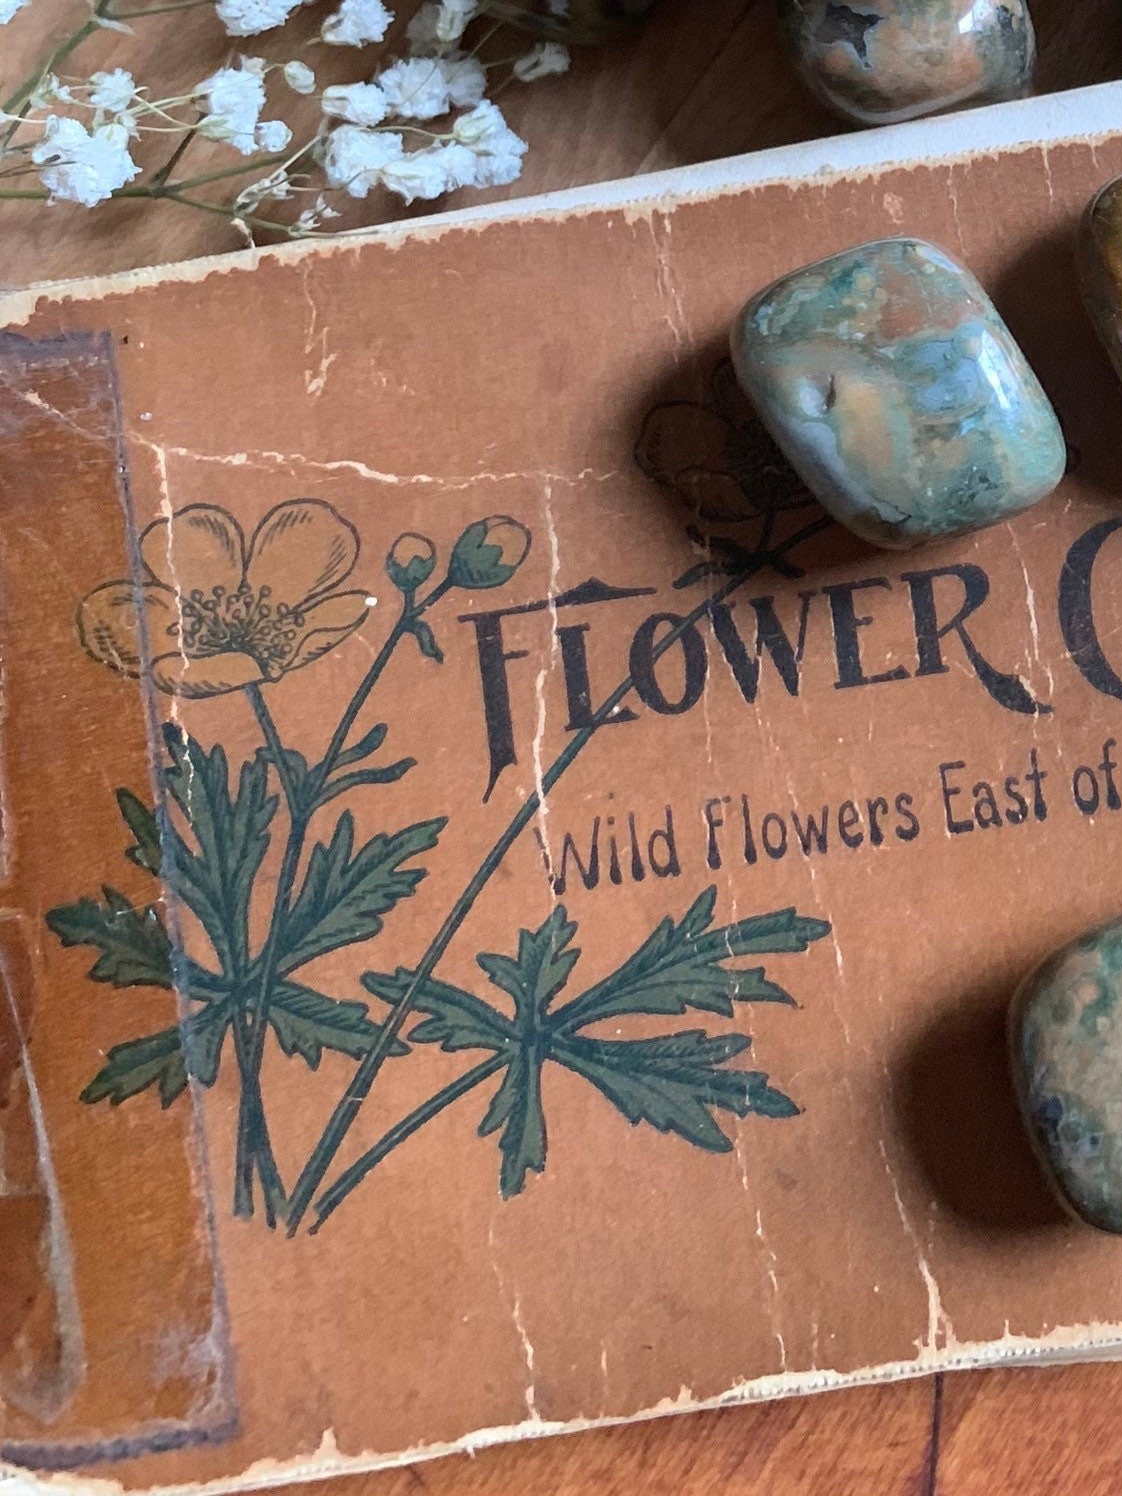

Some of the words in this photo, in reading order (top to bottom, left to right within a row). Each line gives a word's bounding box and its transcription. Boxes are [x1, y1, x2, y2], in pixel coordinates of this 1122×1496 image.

[456, 562, 1055, 806] FLOWER
[533, 798, 681, 895] Wild
[705, 793, 920, 870] Flowers
[939, 748, 1048, 835] East
[1073, 737, 1122, 816] of
